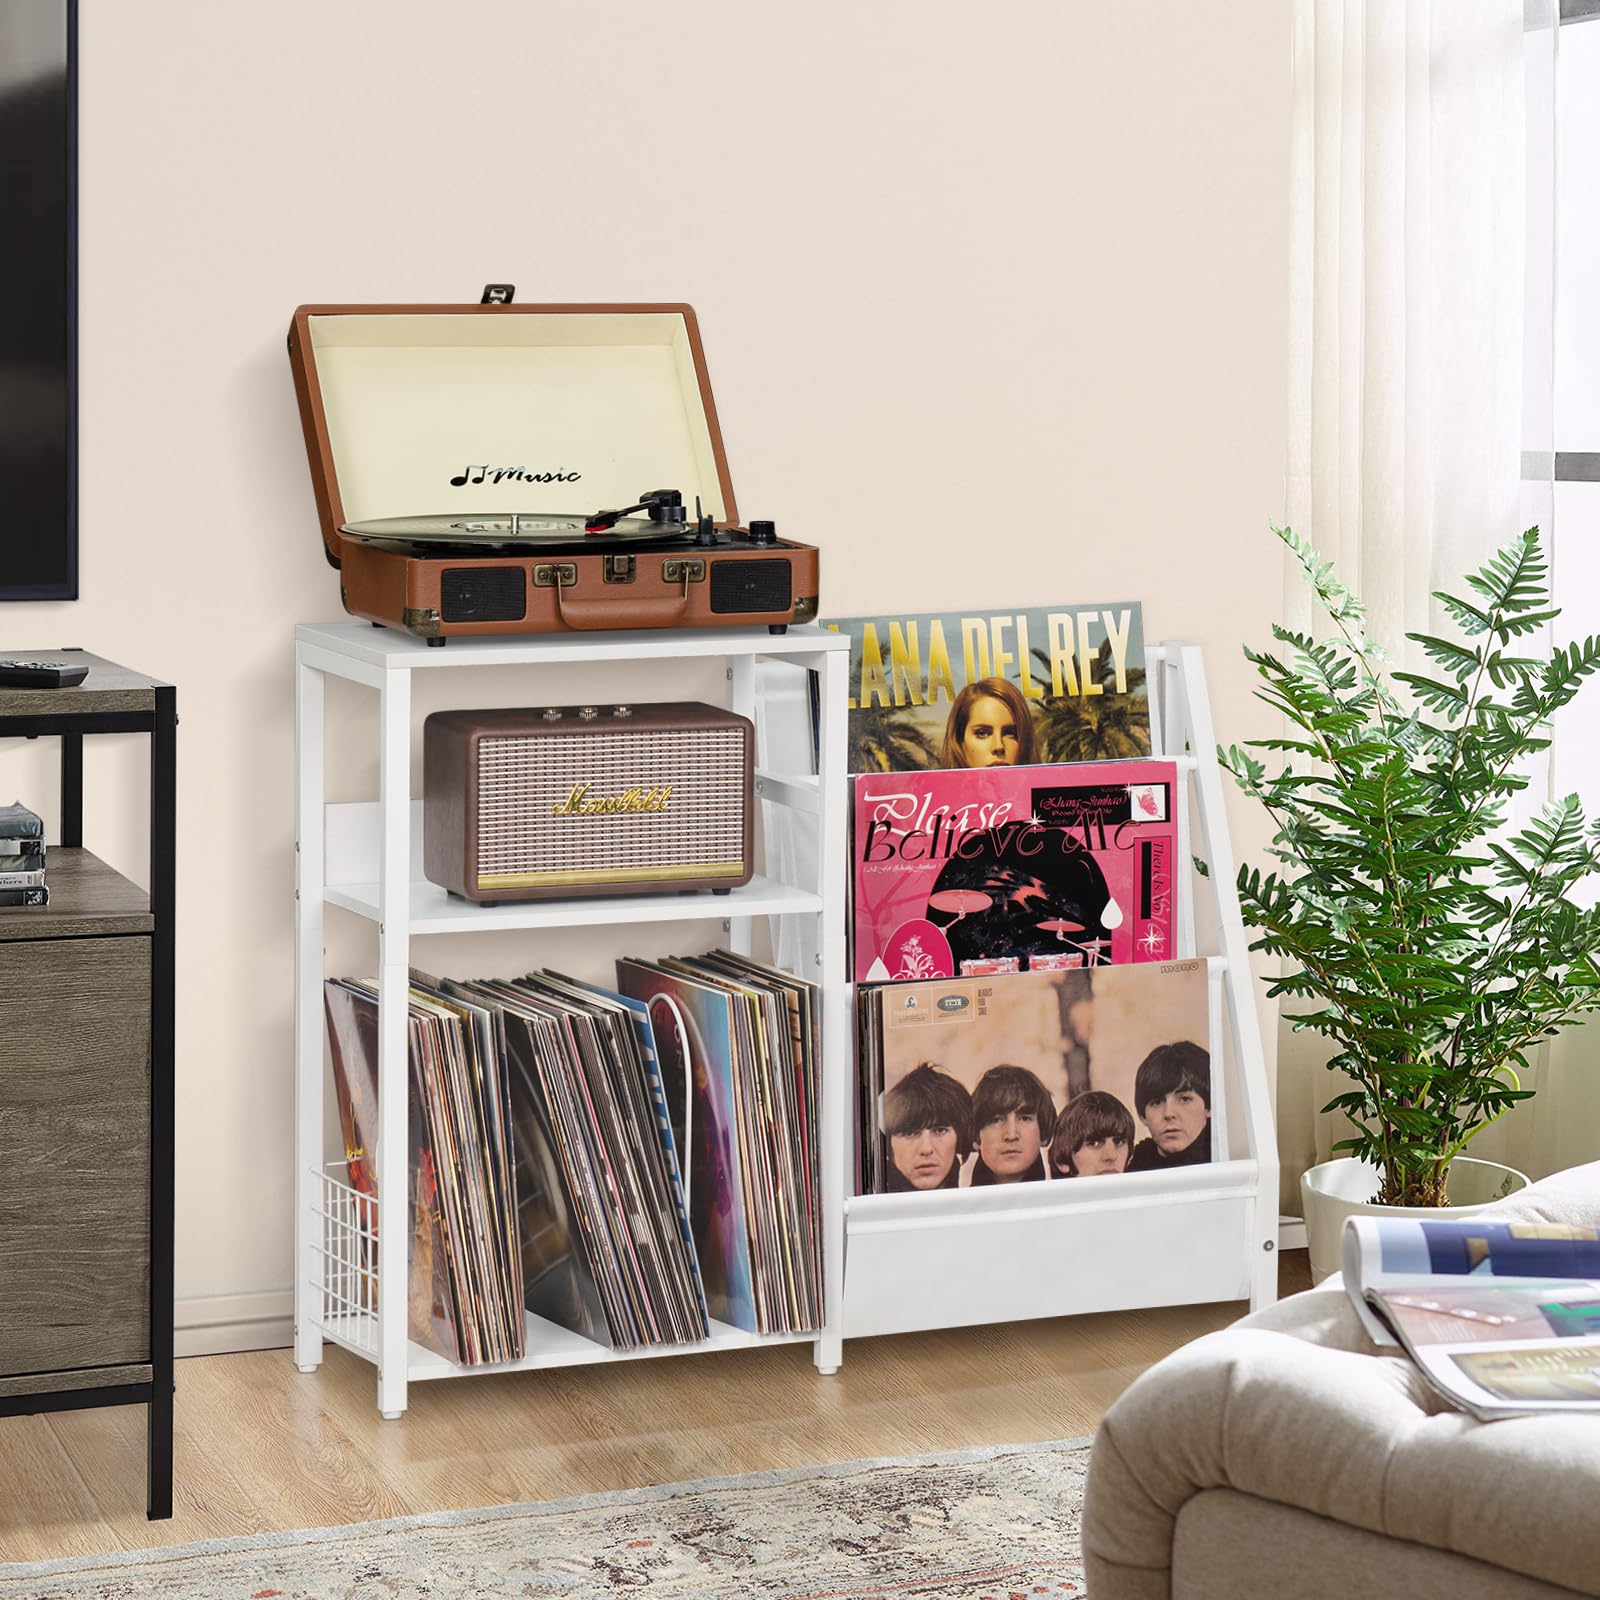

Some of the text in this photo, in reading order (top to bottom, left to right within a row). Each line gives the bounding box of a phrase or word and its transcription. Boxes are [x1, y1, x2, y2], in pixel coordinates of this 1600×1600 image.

[487, 465, 582, 484] Music
[961, 614, 1044, 699] DEL
[1047, 609, 1132, 698] REY
[864, 791, 1013, 836] Please
[863, 807, 1141, 862] Believe Me
[1152, 842, 1164, 877] There
[1160, 962, 1199, 974] mono
